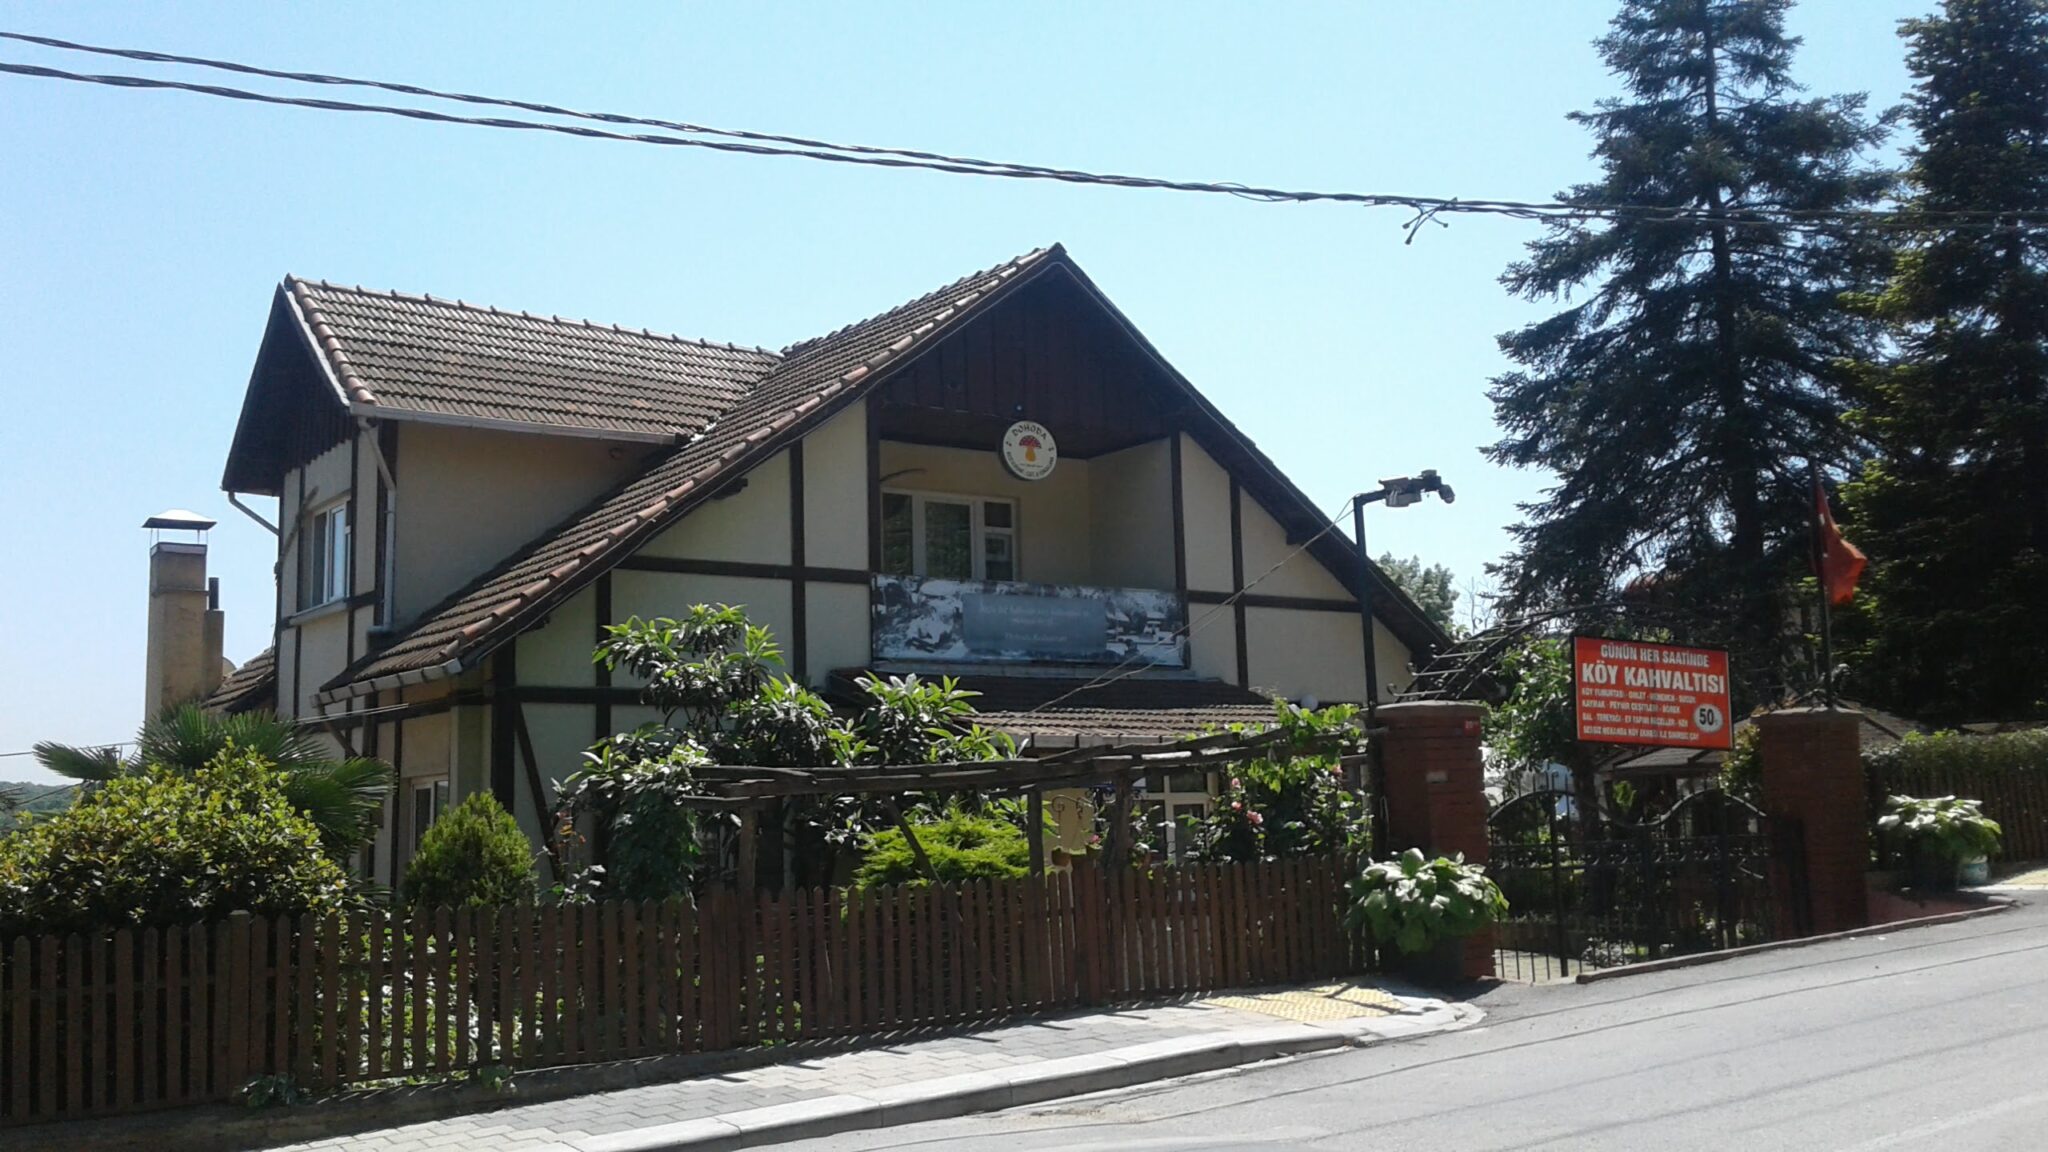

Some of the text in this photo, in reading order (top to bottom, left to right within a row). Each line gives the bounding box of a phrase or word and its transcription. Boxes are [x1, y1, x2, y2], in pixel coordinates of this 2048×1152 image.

[1601, 642, 1710, 668] GÜNÜN HER SAATİNDE
[1582, 660, 1724, 694] KÖY KAHVALTISI
[1699, 708, 1714, 726] 50
